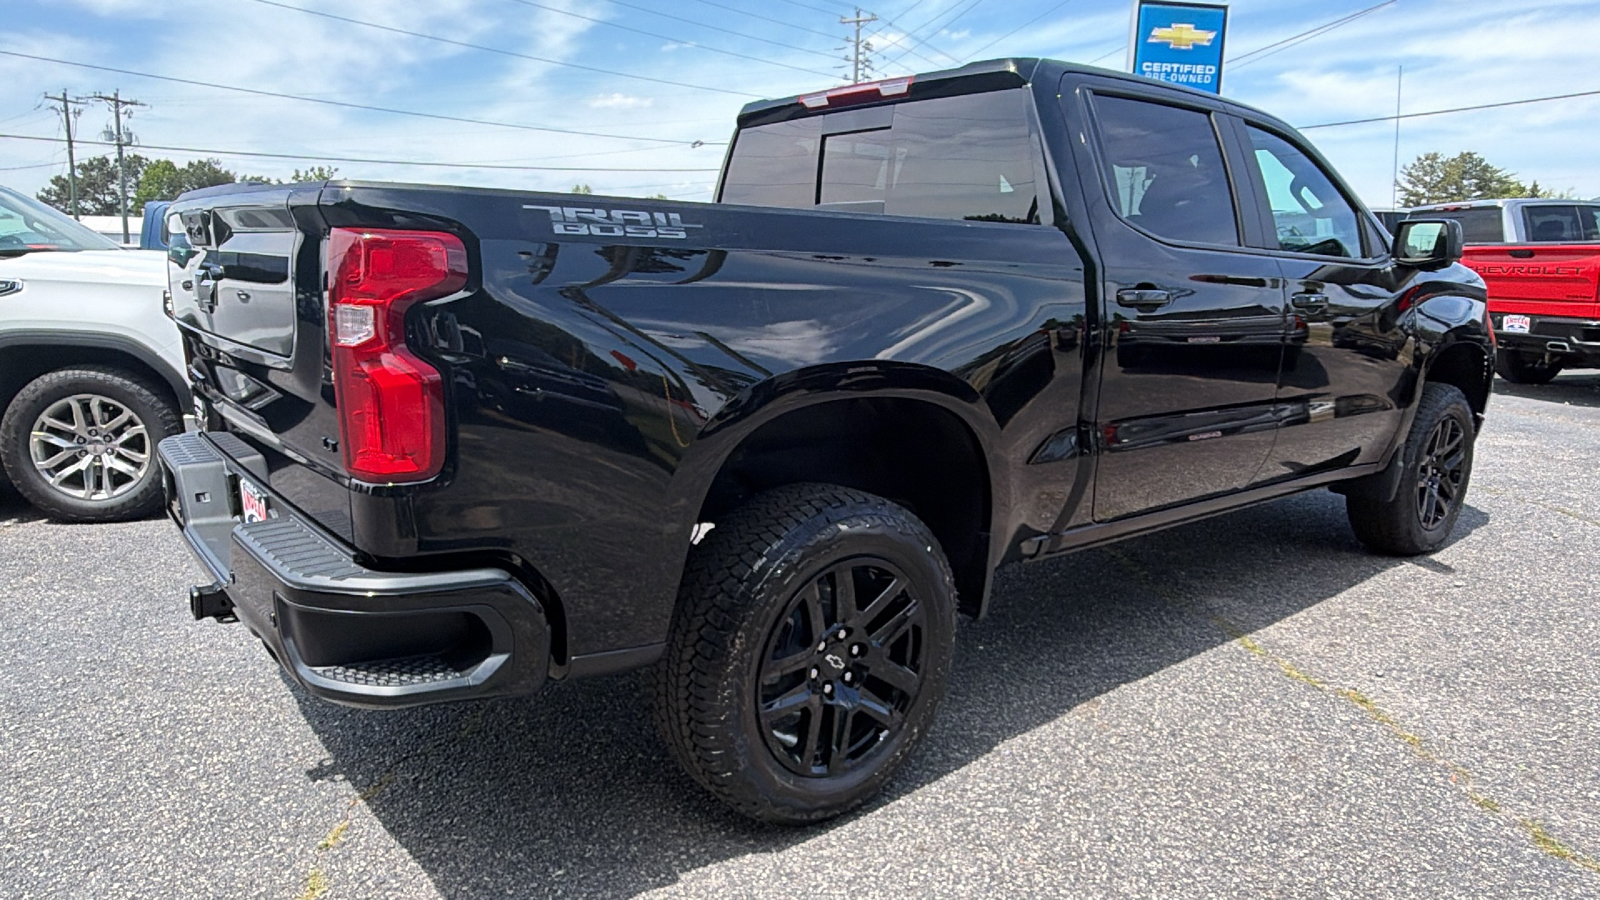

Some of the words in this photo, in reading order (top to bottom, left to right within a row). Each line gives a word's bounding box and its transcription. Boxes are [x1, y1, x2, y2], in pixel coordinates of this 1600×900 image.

[1142, 62, 1216, 74] CERTIFIED
[1145, 72, 1211, 84] PRE-OWNED
[522, 204, 703, 228] TRAIL
[552, 222, 687, 239] BOSS
[1470, 266, 1585, 275] HEVROLET
